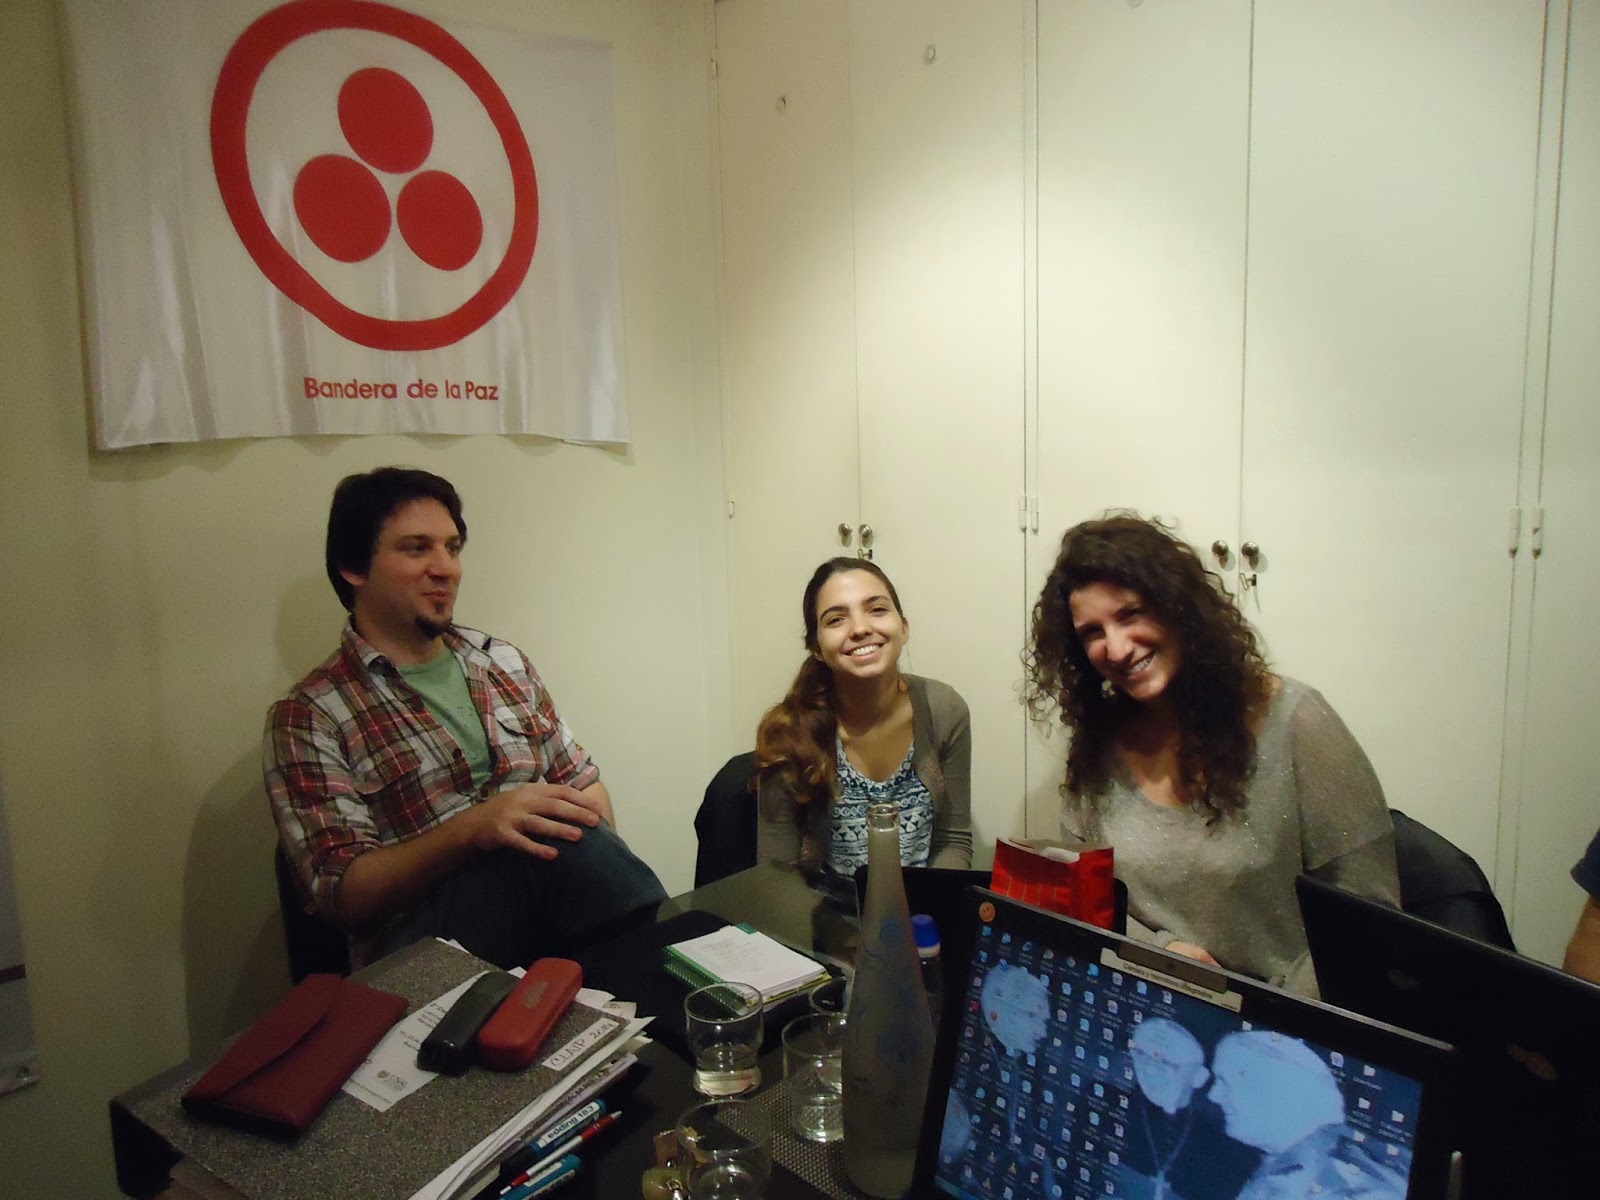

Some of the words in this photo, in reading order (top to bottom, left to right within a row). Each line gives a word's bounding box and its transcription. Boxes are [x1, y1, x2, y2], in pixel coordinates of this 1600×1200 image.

[304, 376, 398, 399] Bandera
[406, 379, 439, 399] de
[444, 379, 461, 399] la
[465, 381, 499, 400] Paz
[589, 1023, 614, 1039] 2014
[547, 1117, 578, 1139] edding
[577, 1105, 595, 1119] 183
